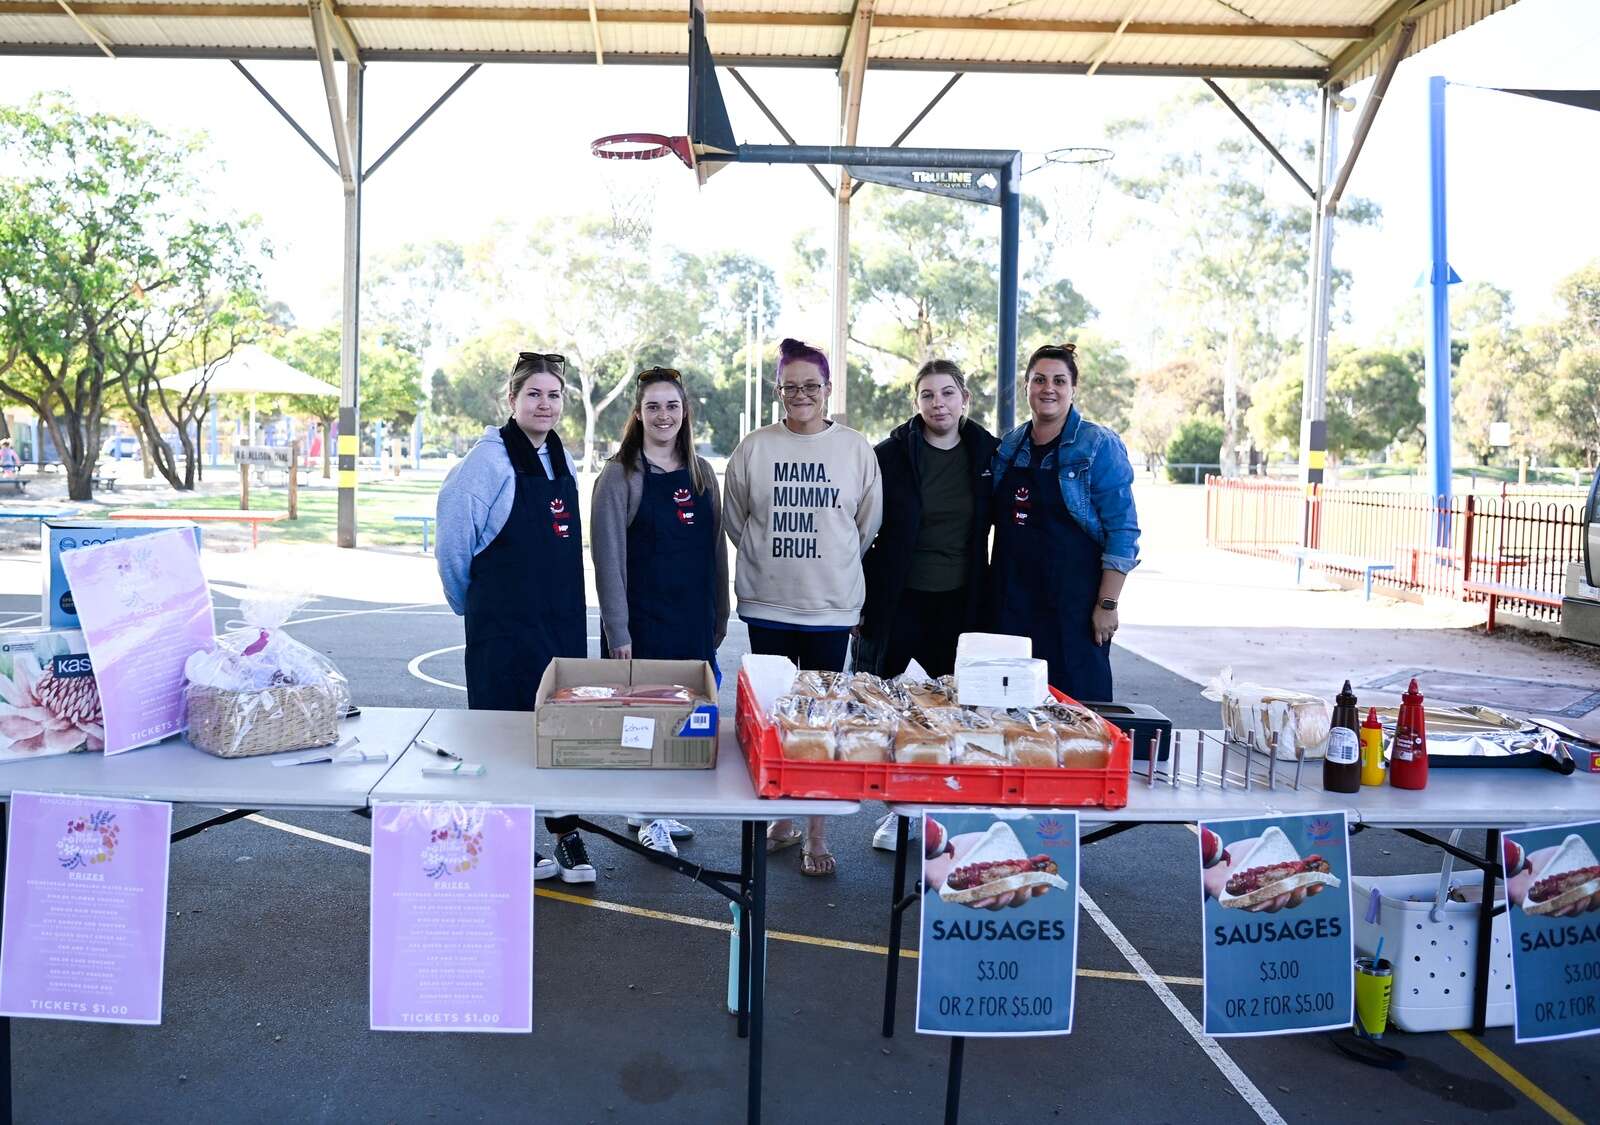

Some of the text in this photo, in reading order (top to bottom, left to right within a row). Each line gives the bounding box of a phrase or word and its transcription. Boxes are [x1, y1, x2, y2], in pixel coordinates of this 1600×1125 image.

[774, 462, 831, 483] MAMA.
[773, 486, 842, 509] MUMMY.
[772, 511, 818, 533] MUM.
[772, 536, 822, 559] BRUH.
[131, 720, 173, 741] TICKETS
[931, 919, 1066, 941] SAUSAGES
[1214, 916, 1343, 946] SAUSAGES
[1520, 923, 1600, 952] SAUSA
[977, 960, 1019, 981] $3.00
[1259, 959, 1300, 982] $3.00
[31, 999, 128, 1015] TICKETS $1.00
[939, 995, 1053, 1018] OR 2 FOR $5.00
[1225, 991, 1334, 1018] OR 2 FOR $5.00
[1535, 995, 1597, 1023] OR 2 FOR
[402, 1012, 500, 1024] TICKETS $1.00
